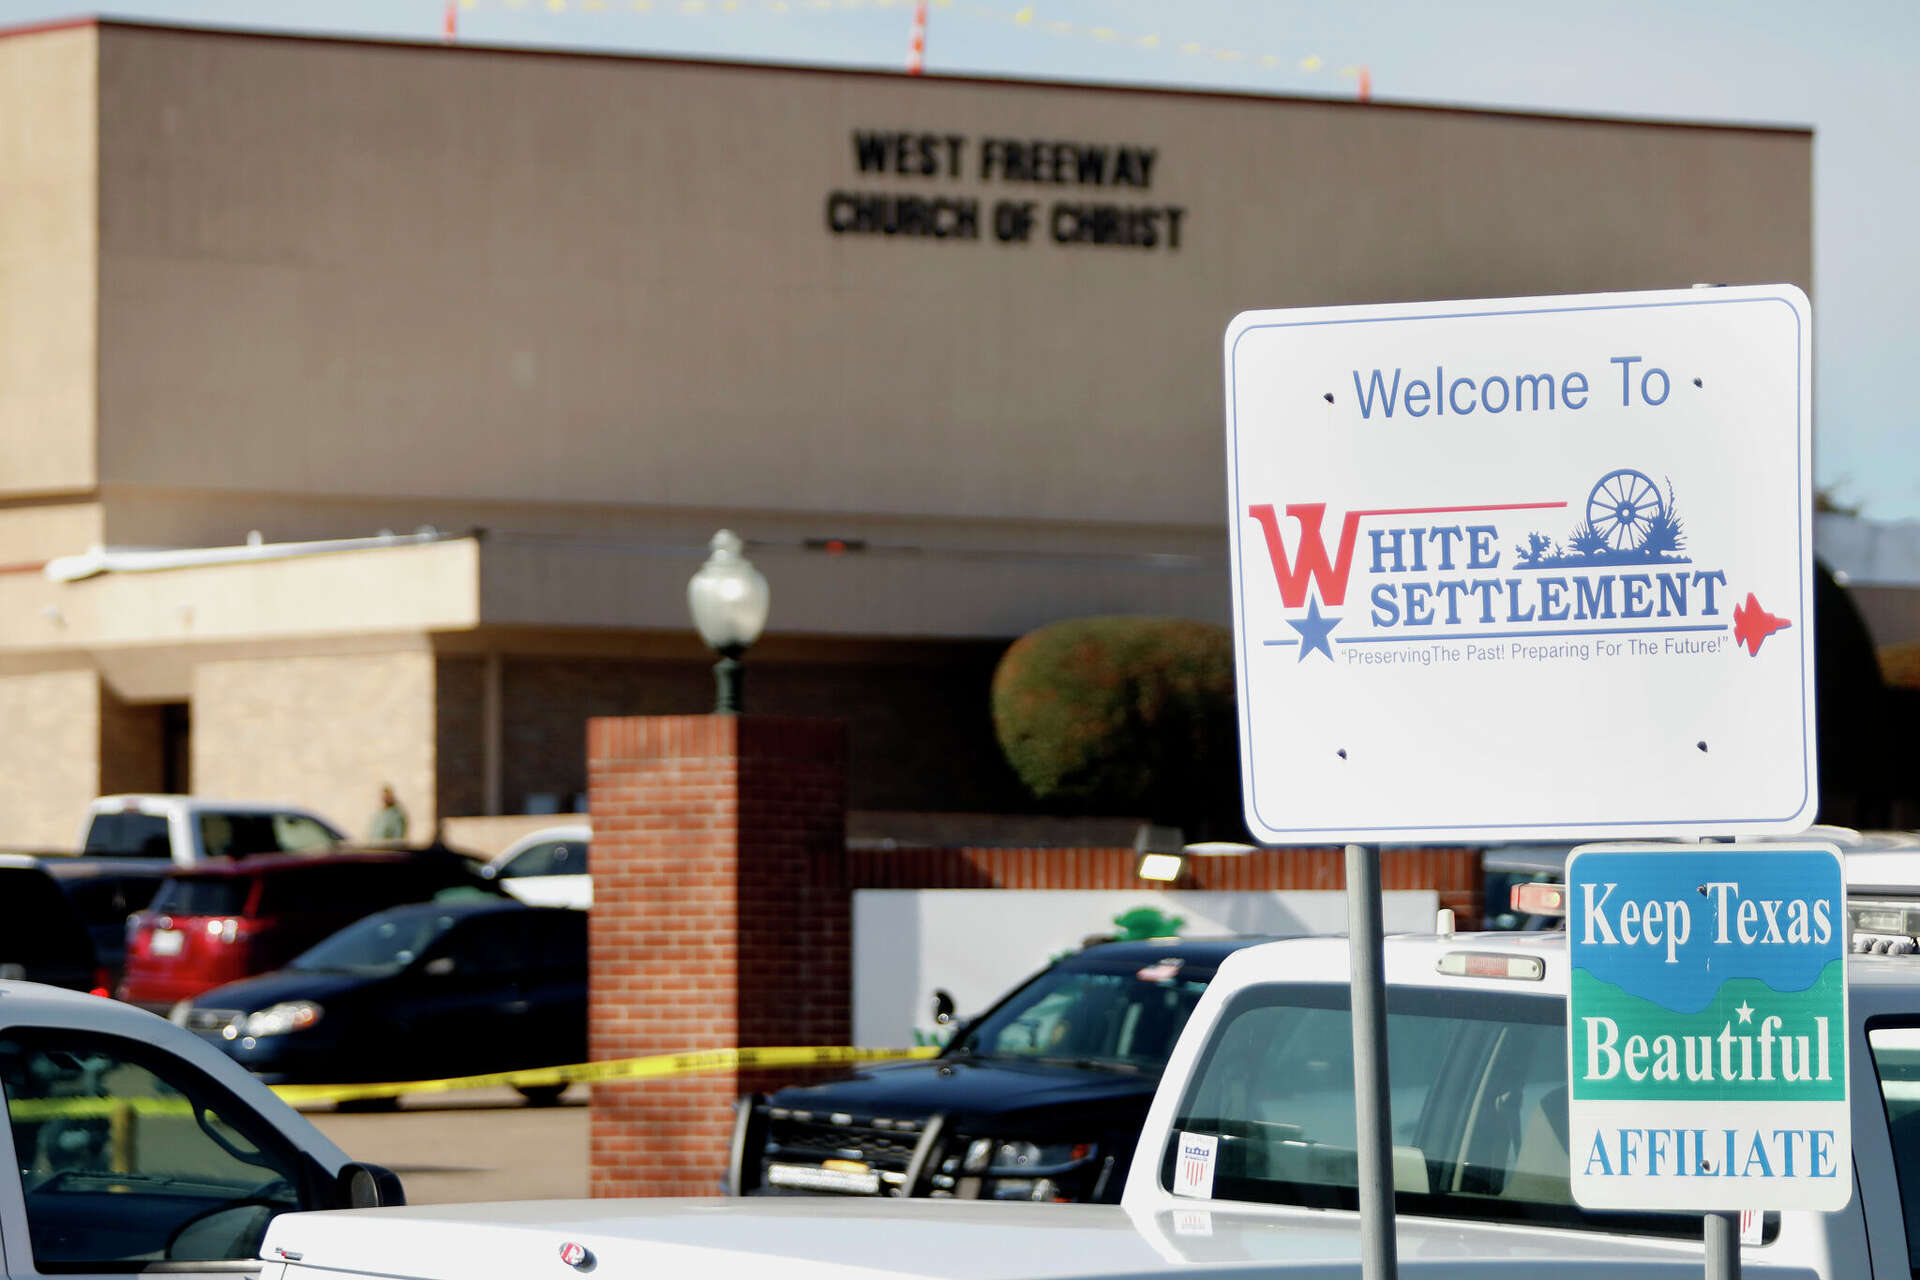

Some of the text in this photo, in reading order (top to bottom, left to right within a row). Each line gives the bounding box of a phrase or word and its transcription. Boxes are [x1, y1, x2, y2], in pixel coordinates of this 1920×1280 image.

[854, 131, 1157, 188] WEST FREEWAY
[826, 190, 1186, 252] CHURCH OF CHRIST
[1353, 356, 1670, 419] Welcome To
[1249, 502, 1500, 608] WHITE
[1371, 569, 1727, 628] SETTLEMENT
[1467, 644, 1505, 661] Past!
[1512, 641, 1589, 661] Preparing
[1596, 640, 1623, 657] For
[1628, 638, 1658, 655] The
[1580, 881, 1833, 964] Keep Texas
[1582, 1012, 1833, 1082] Beautiful
[1584, 1127, 1837, 1179] AFFILIATE
